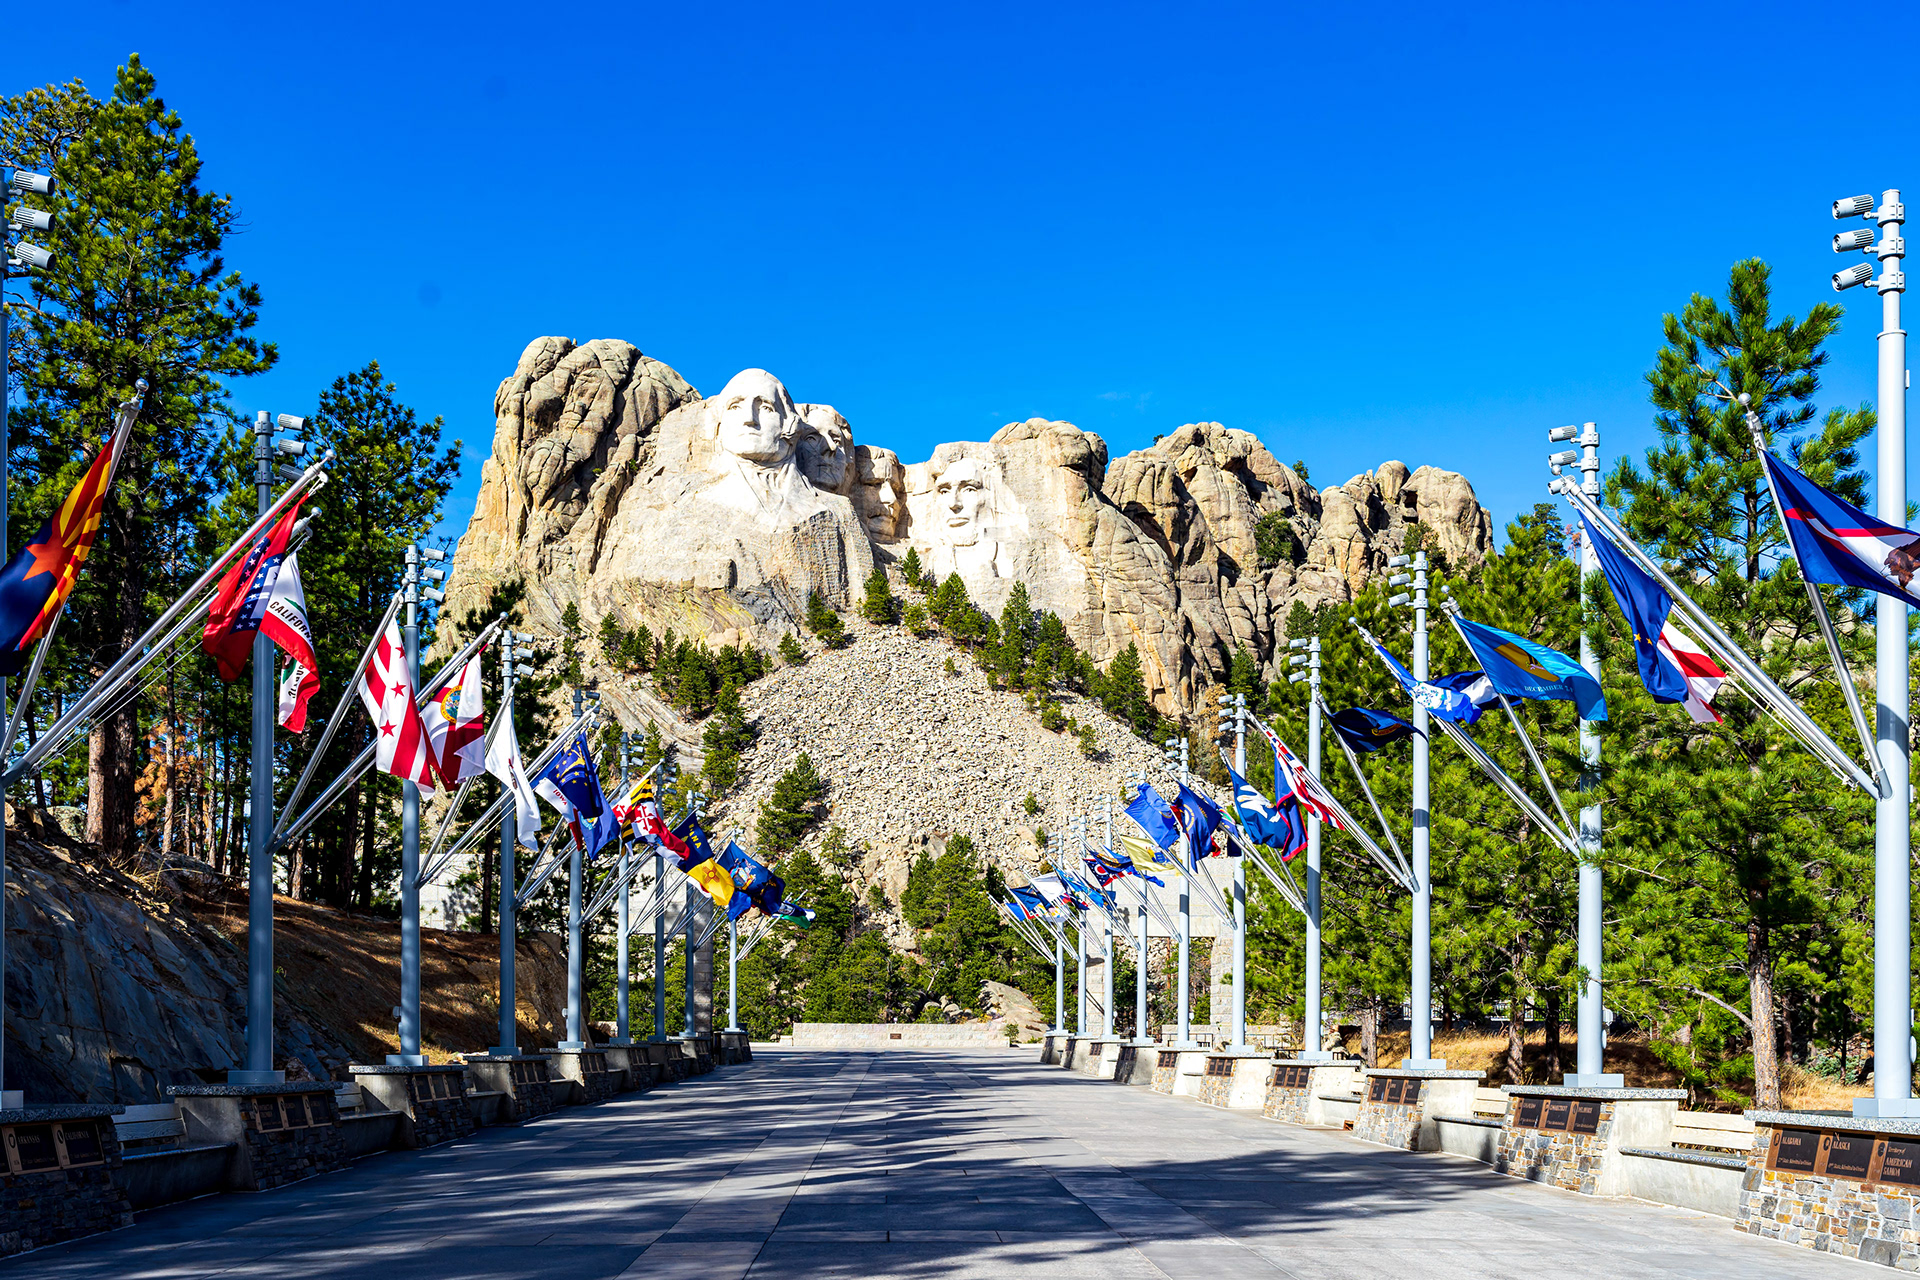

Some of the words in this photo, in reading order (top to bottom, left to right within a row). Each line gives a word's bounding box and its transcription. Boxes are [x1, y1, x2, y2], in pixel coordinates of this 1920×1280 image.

[270, 601, 313, 642] CALIFORN
[553, 789, 567, 805] IOWA
[1885, 1157, 1913, 1168] AMERICAN
[1883, 1166, 1901, 1177] SAMOA
